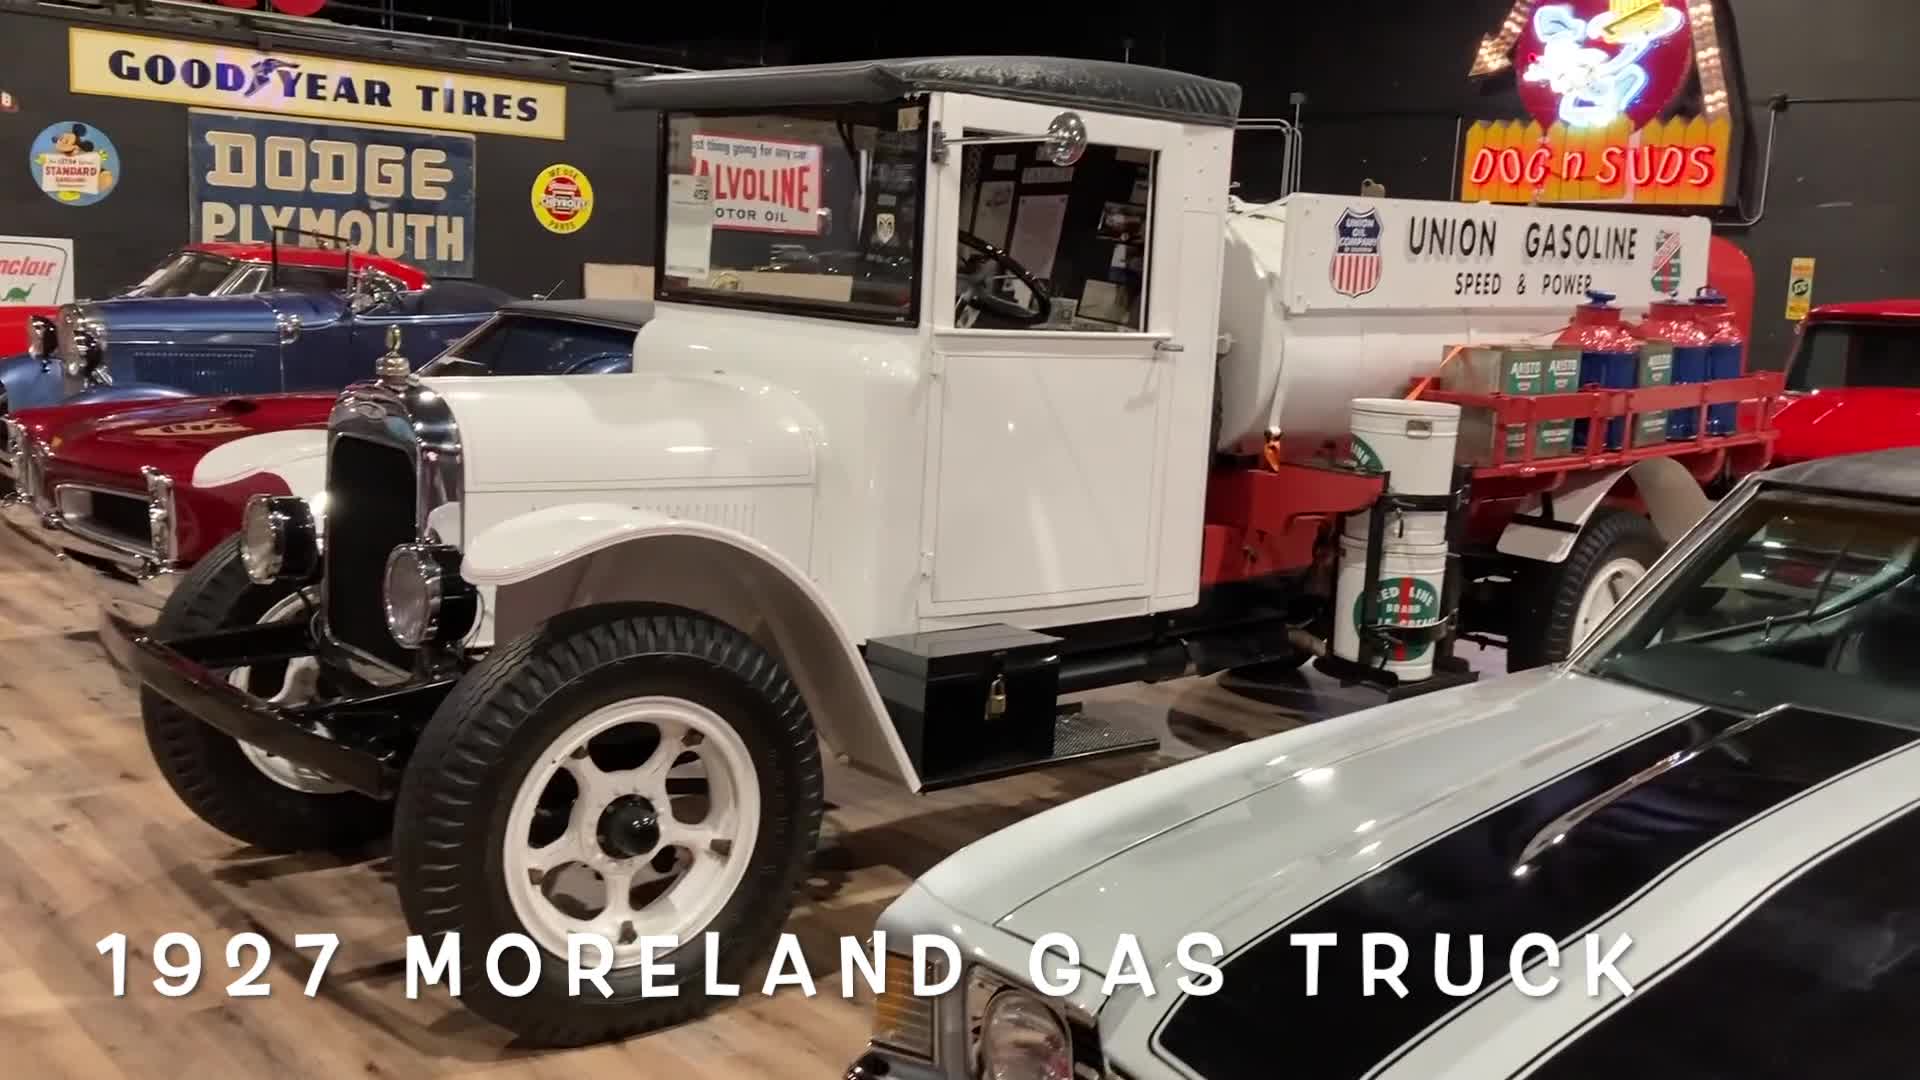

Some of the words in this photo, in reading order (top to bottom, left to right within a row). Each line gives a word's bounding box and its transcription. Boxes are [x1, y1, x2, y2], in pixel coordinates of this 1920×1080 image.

[108, 49, 392, 107] GOODYEAR
[415, 83, 538, 122] TIRES
[205, 130, 454, 200] DODGE
[760, 144, 773, 156] for
[45, 166, 97, 177] STANDARD
[1470, 146, 1552, 186] DOG
[1560, 150, 1585, 182] n
[1594, 145, 1717, 188] SUDS
[691, 159, 811, 213] LVOLINE
[714, 207, 757, 221] OTOR
[764, 210, 788, 223] OIL
[1345, 218, 1375, 228] UNION
[202, 202, 464, 262] PLYMOUTH
[1352, 228, 1368, 237] OIL
[1409, 216, 1496, 256] UNION
[1525, 222, 1638, 260] GASOLINE
[1454, 272, 1501, 295] SPEED
[1516, 273, 1526, 295] &
[1542, 274, 1592, 296] POWER
[1408, 586, 1434, 607] LINE
